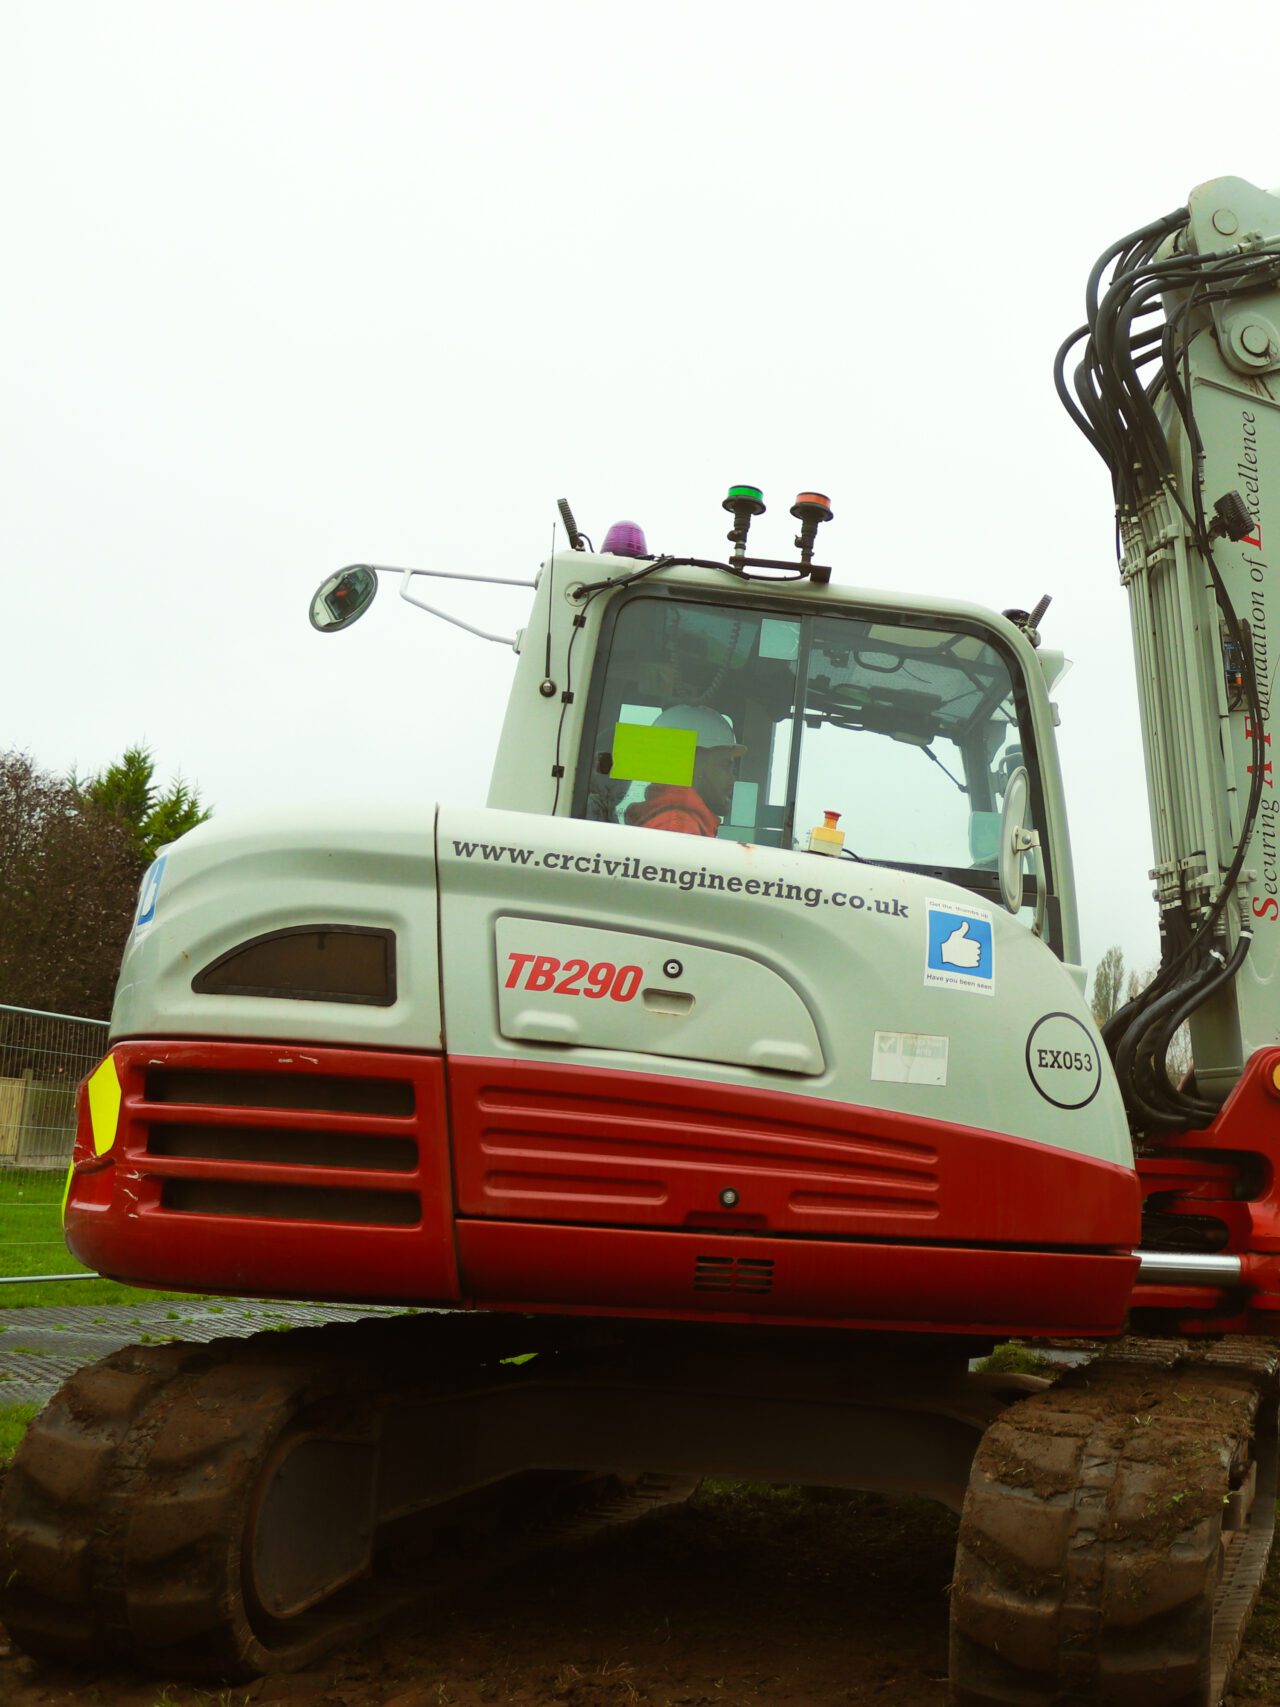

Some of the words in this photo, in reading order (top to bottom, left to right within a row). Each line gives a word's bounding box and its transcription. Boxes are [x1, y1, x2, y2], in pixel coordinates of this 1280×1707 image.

[1242, 552, 1268, 583] of
[452, 839, 909, 918] www.crcivilengineering.co.uk
[1252, 799, 1280, 921] Securing
[504, 952, 643, 1003] TB290
[926, 974, 944, 982] Have
[959, 979, 976, 987] been
[976, 983, 992, 991] seen
[1037, 1049, 1093, 1072] EX053
